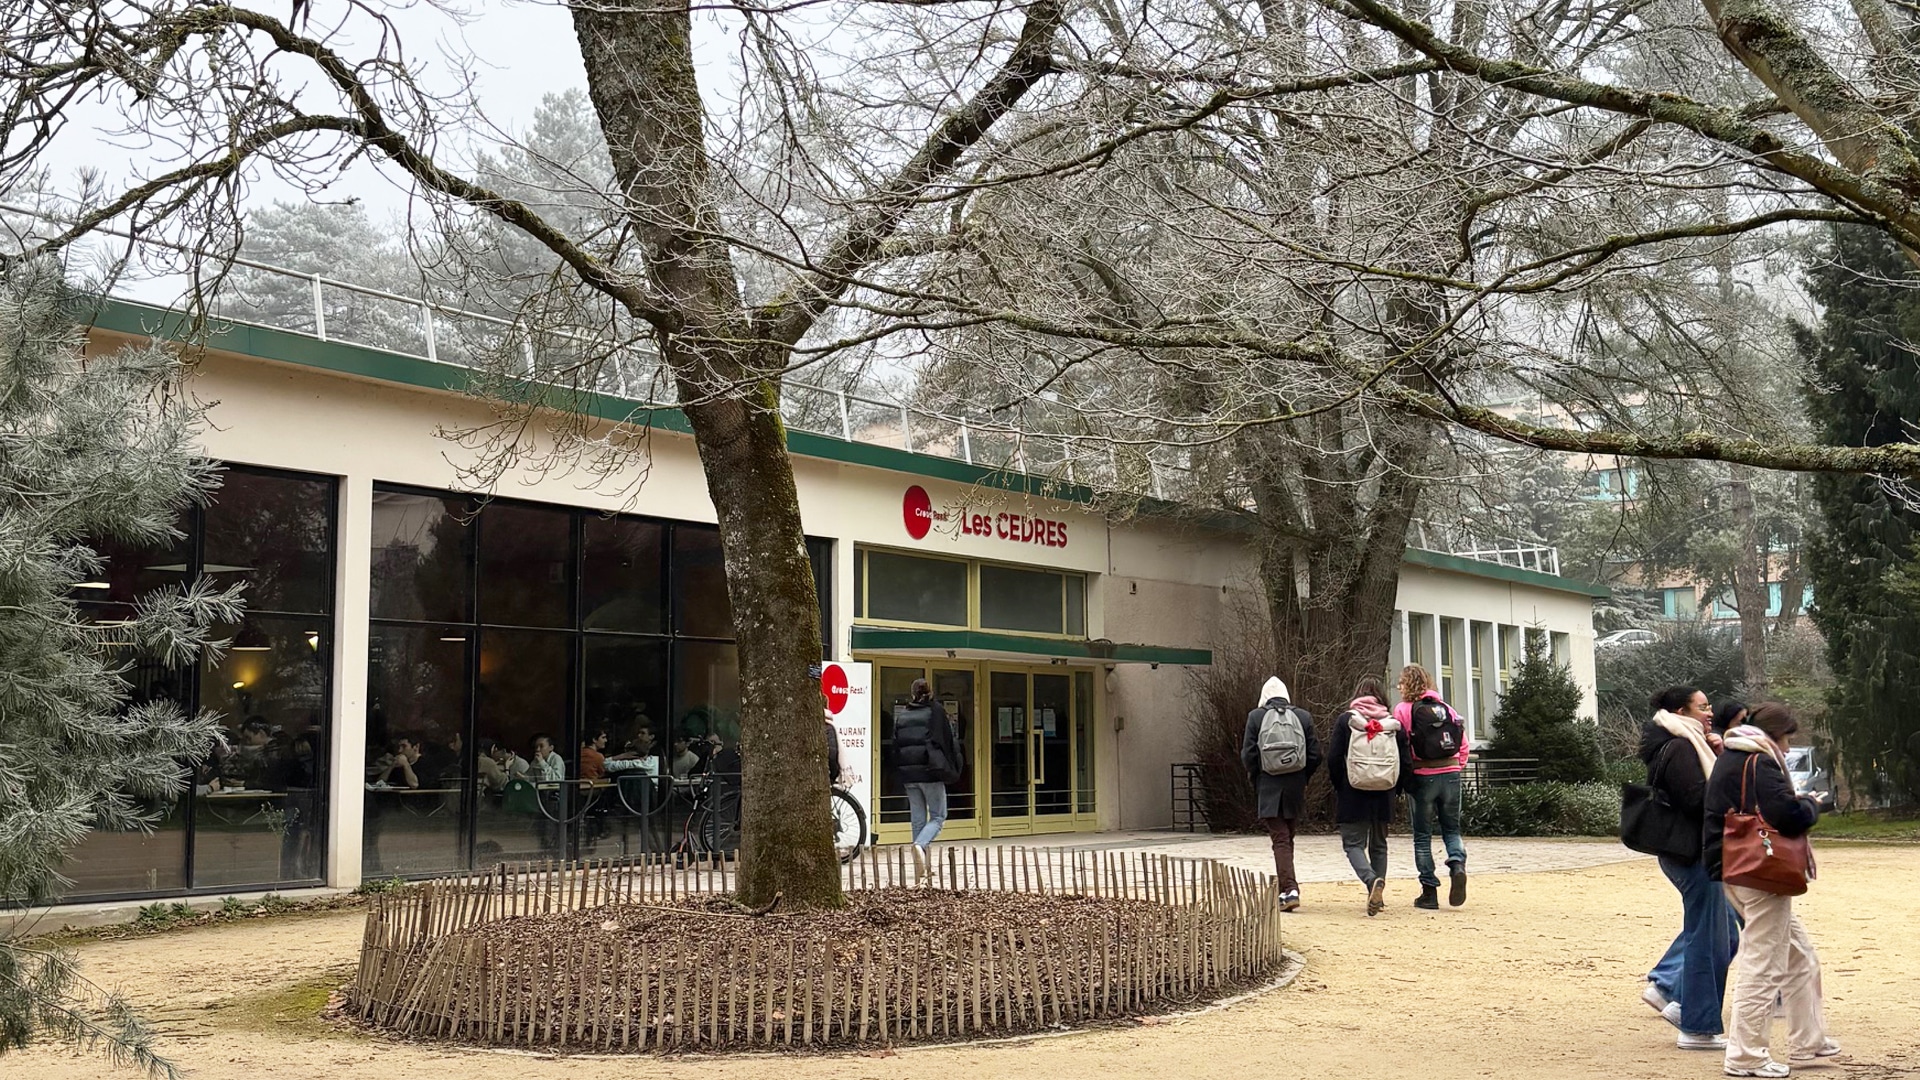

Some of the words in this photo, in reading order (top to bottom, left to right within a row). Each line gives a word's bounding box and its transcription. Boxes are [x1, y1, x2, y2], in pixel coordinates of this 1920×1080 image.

[962, 506, 992, 537] Les
[996, 512, 1068, 548] CEDRES
[838, 727, 866, 736] AURANT
